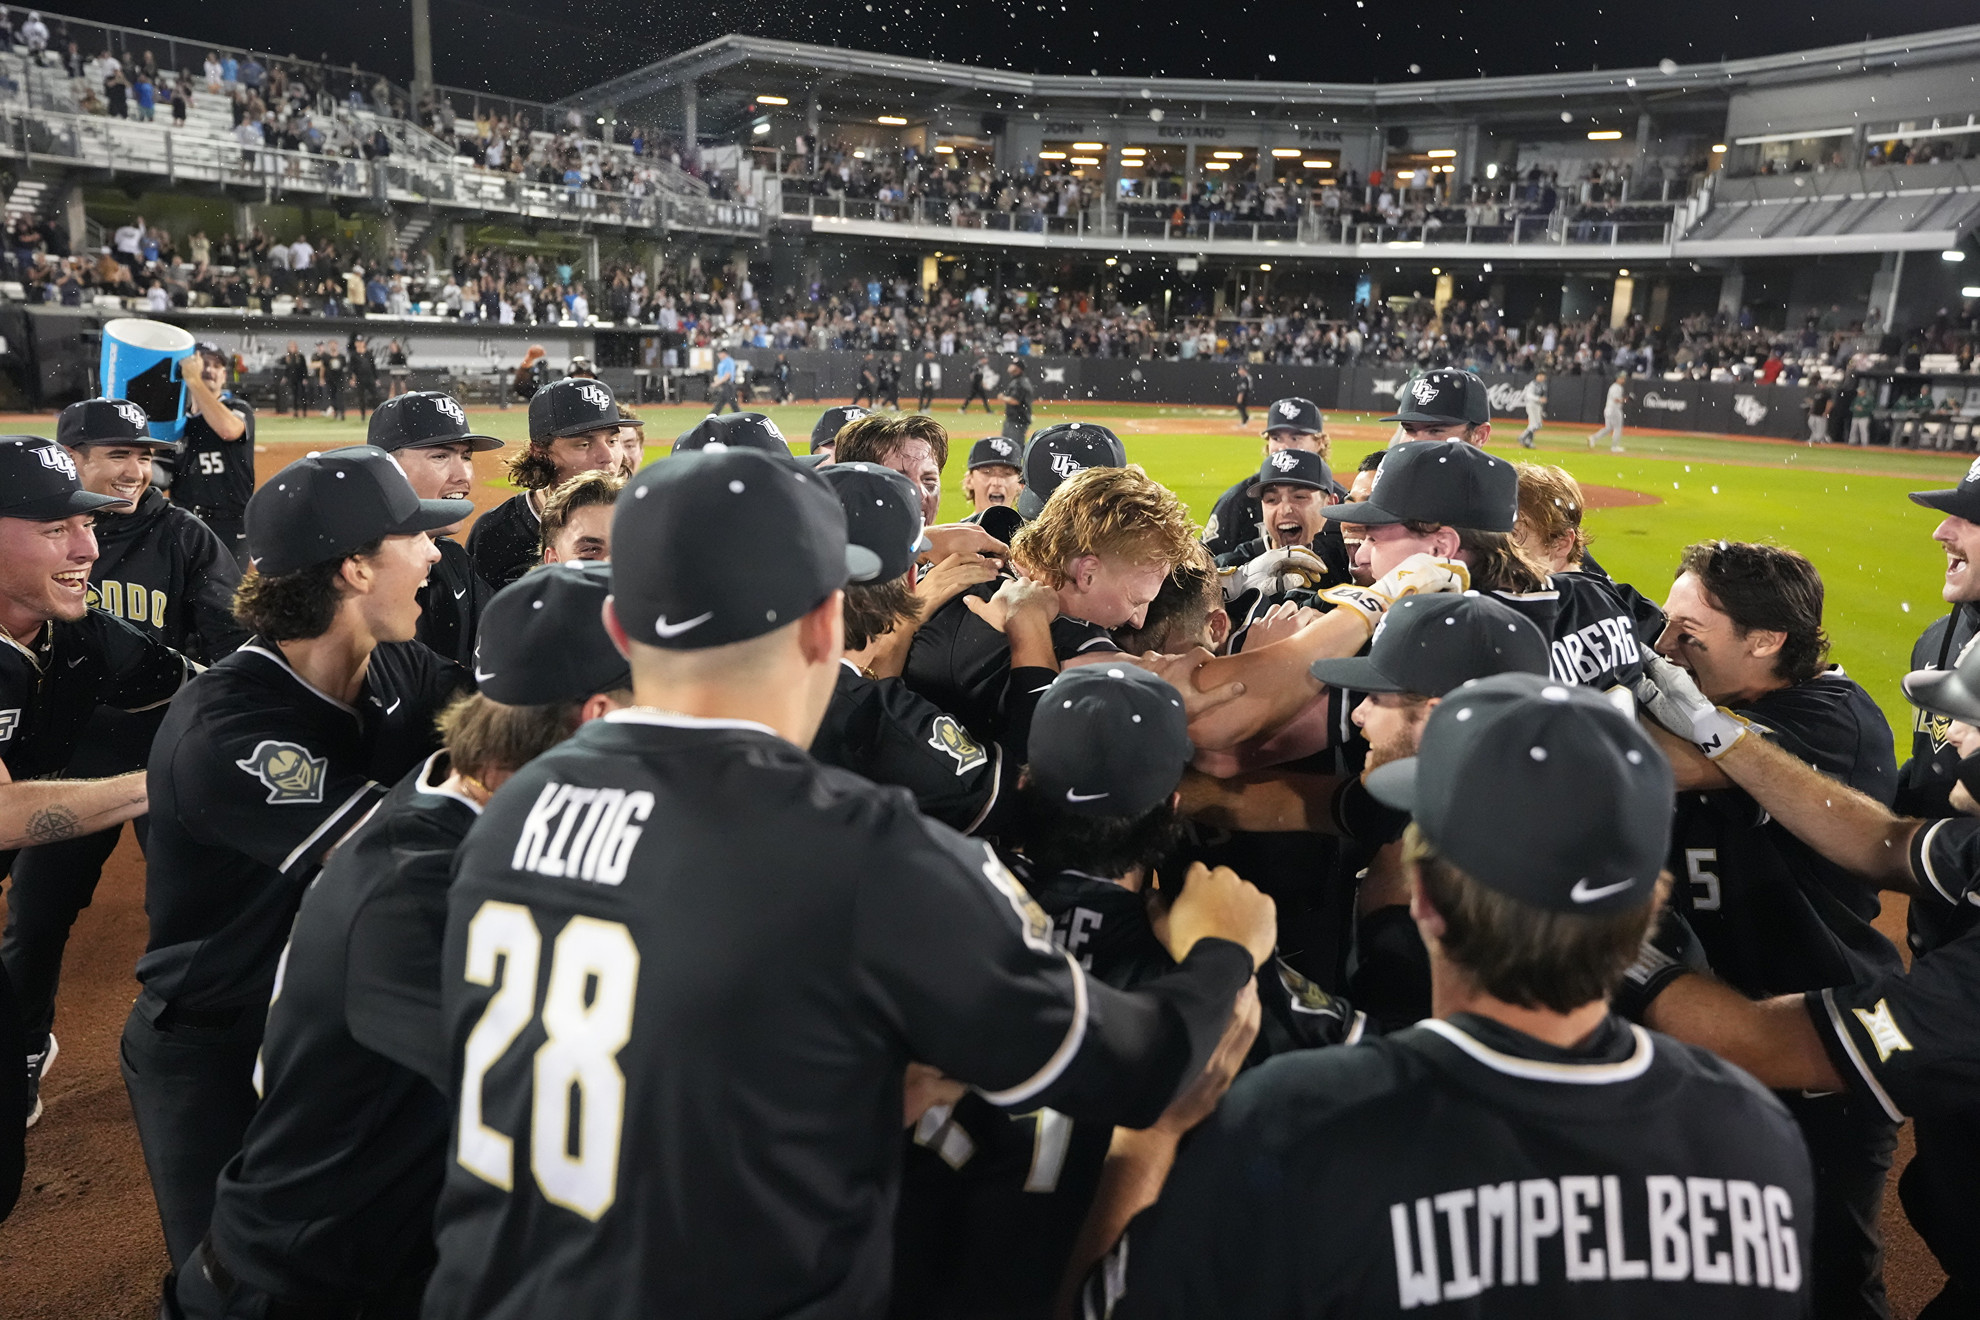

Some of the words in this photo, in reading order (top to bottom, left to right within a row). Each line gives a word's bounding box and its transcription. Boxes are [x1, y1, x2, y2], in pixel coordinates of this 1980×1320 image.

[575, 384, 610, 411] UCF
[1411, 378, 1439, 406] UCF
[112, 404, 145, 429] UCF
[428, 398, 465, 425] UCF
[1278, 401, 1301, 420] UCF
[989, 438, 1012, 456] UCF
[28, 444, 77, 480] UCF
[198, 451, 225, 475] 55
[1271, 451, 1300, 472] UCF
[1332, 588, 1384, 613] EAS
[1550, 616, 1640, 688] OBERG
[511, 781, 656, 886] KING
[1684, 848, 1721, 911] 5
[456, 900, 642, 1223] 28
[1390, 1175, 1802, 1310] WIMPELBERG
